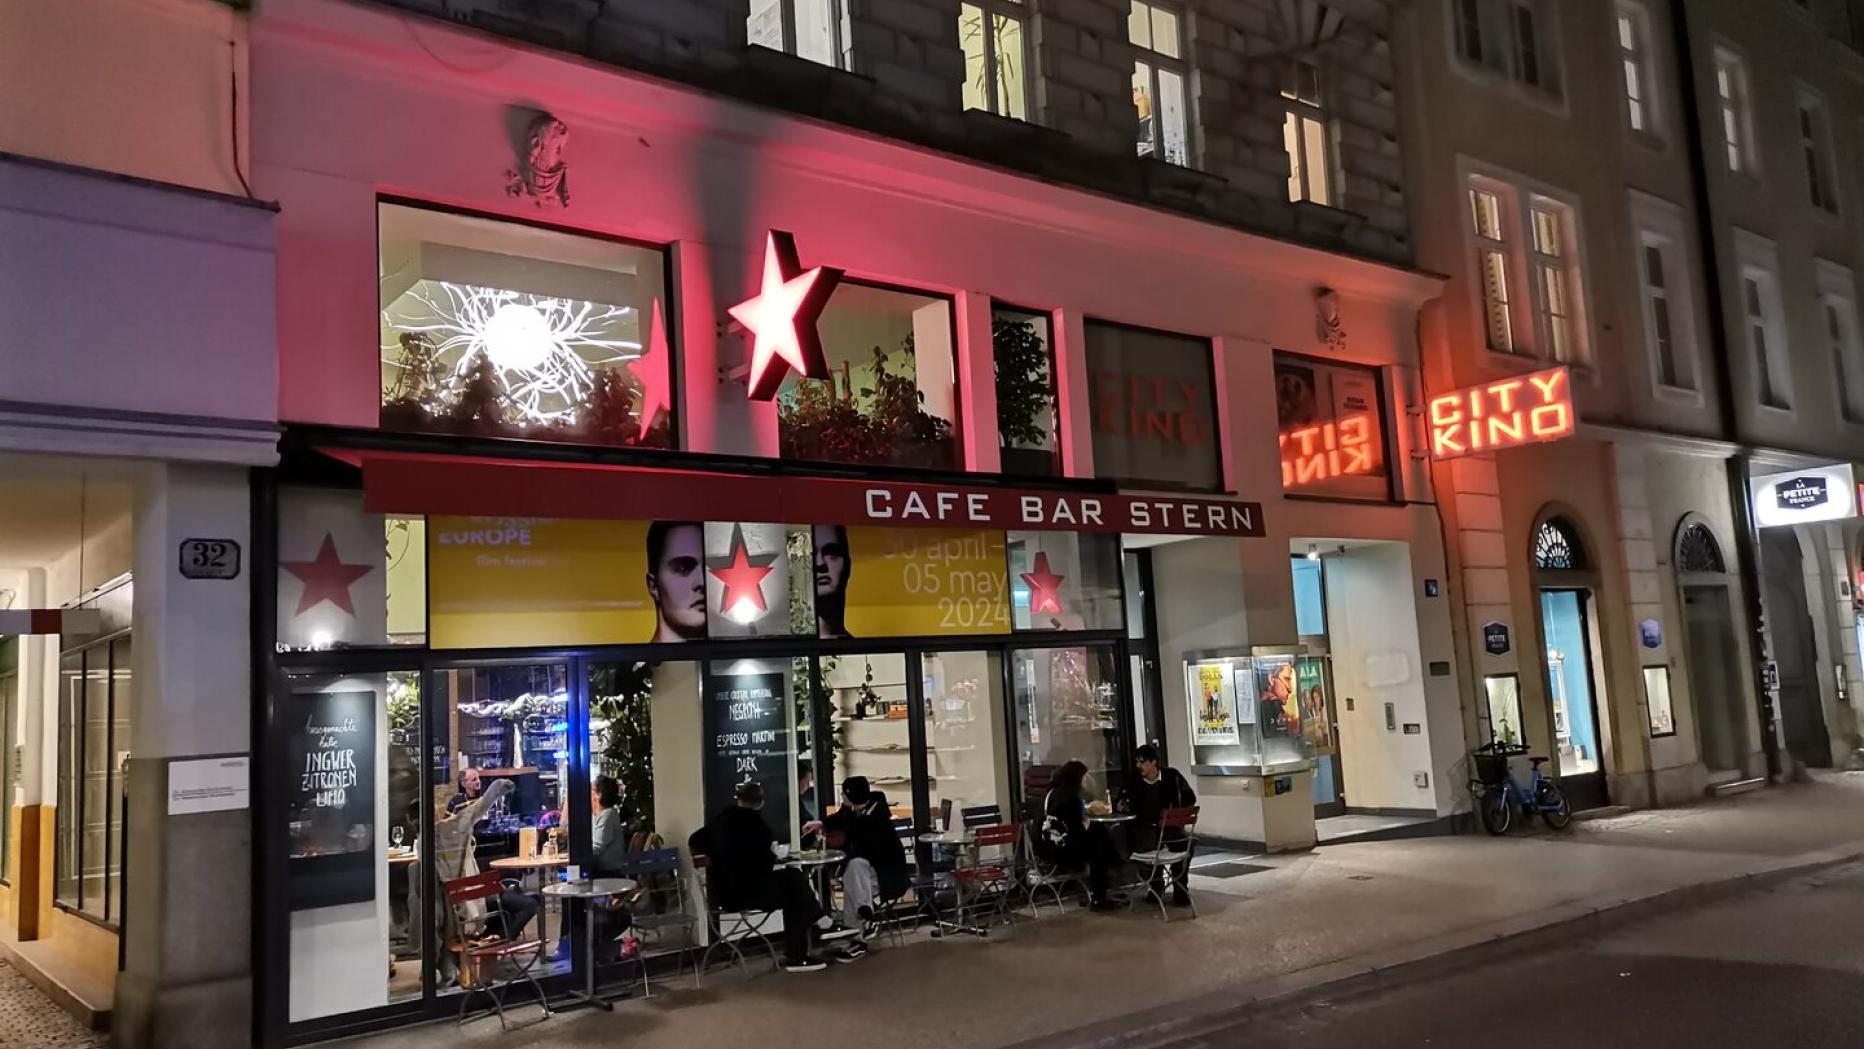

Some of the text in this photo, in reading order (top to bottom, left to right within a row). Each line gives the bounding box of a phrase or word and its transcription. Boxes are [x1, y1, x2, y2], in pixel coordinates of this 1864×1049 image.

[1431, 370, 1563, 425] CITY
[1433, 403, 1567, 456] KINO
[1783, 486, 1820, 499] PETITE
[1789, 496, 1815, 504] FRANCE
[865, 489, 1252, 530] CAFE BAR STERN
[193, 543, 226, 567] 32
[927, 531, 986, 567] april
[903, 562, 1007, 601] 05 may
[938, 596, 1009, 627] 2024
[306, 748, 356, 773] INGWER
[301, 768, 357, 791] ZITRONEN
